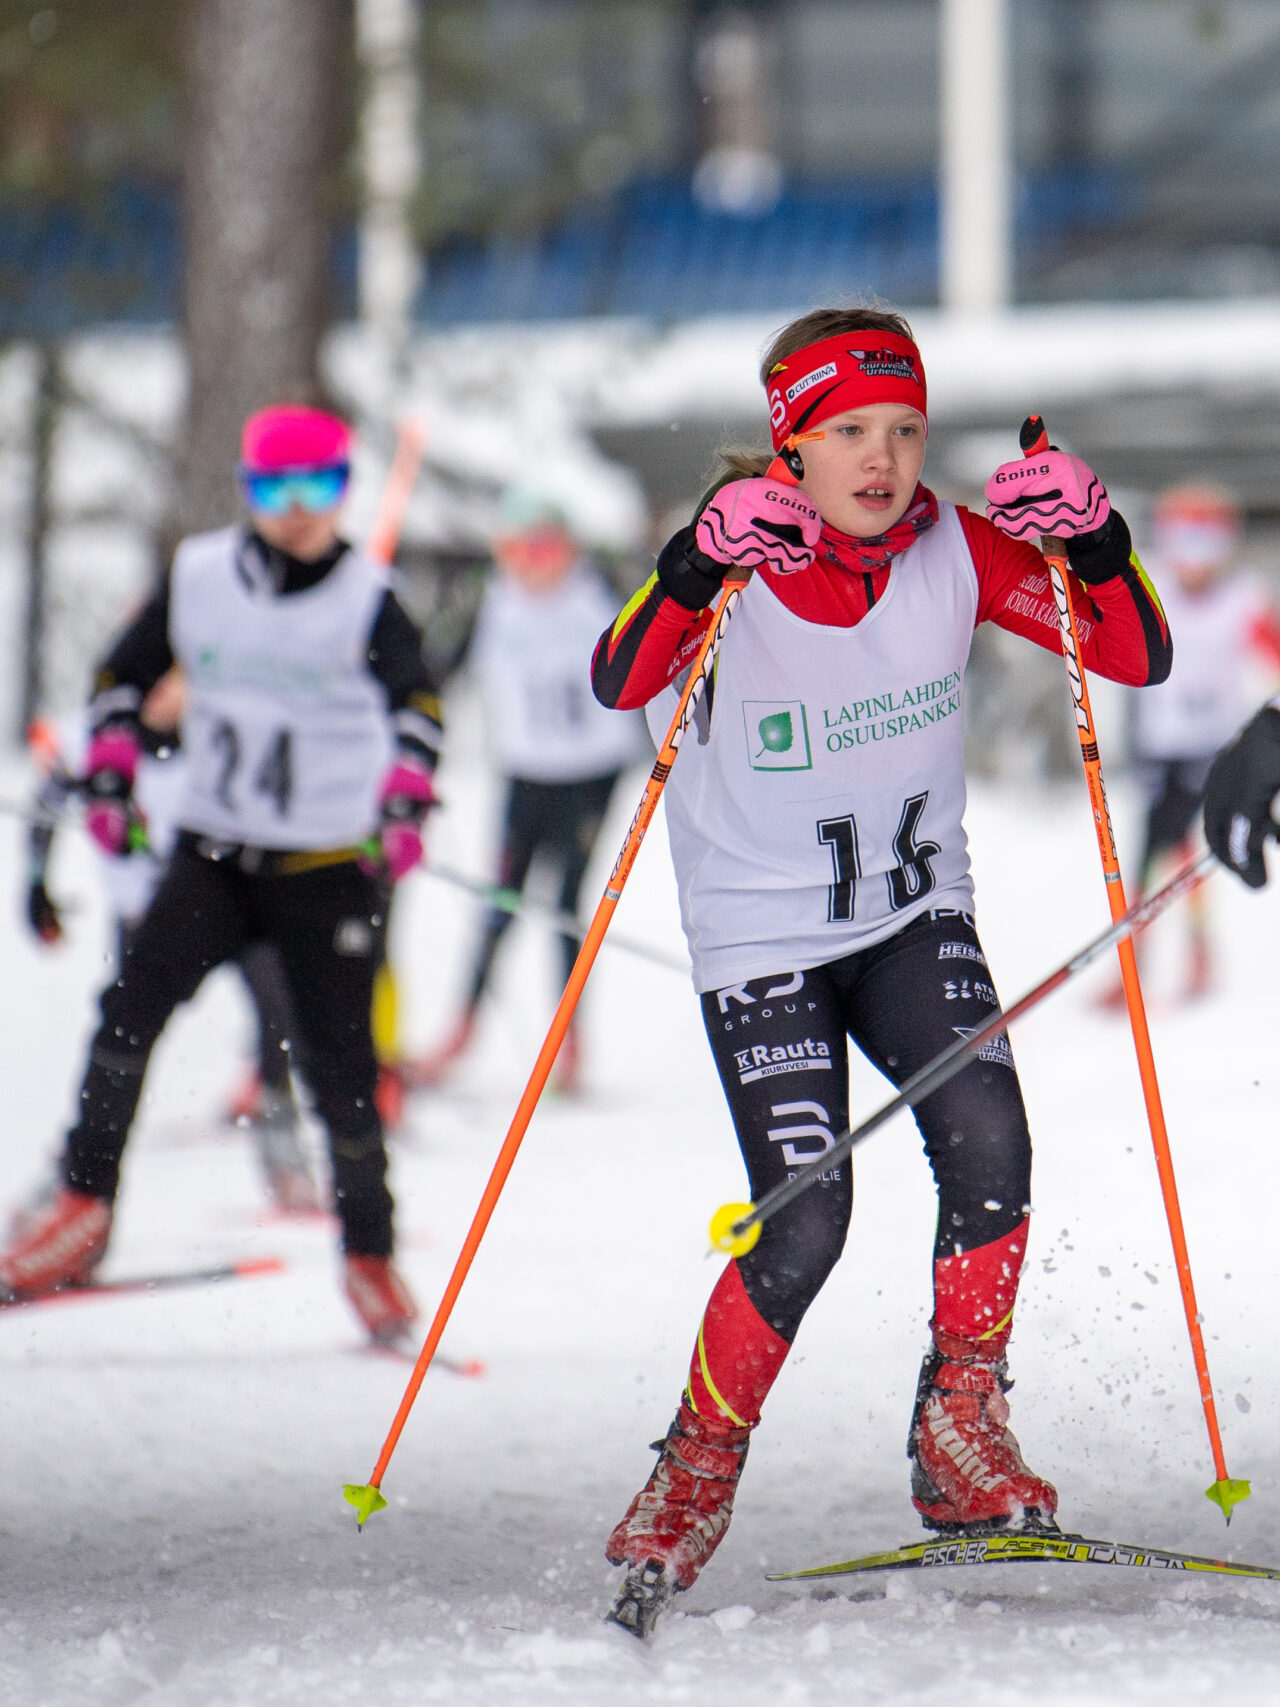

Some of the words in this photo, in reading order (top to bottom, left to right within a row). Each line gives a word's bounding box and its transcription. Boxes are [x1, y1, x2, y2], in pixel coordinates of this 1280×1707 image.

[995, 464, 1050, 484] Going
[765, 490, 817, 520] Going
[823, 666, 961, 728] LAPINLAHDEN
[826, 690, 961, 752] OSUUSPANKKI
[208, 714, 296, 822] 24
[815, 789, 942, 923] 16
[724, 1002, 817, 1031] GROUP
[760, 1061, 809, 1077] KIURUVESI
[787, 1170, 842, 1183] DHLIE
[921, 1540, 989, 1568] FISCHER
